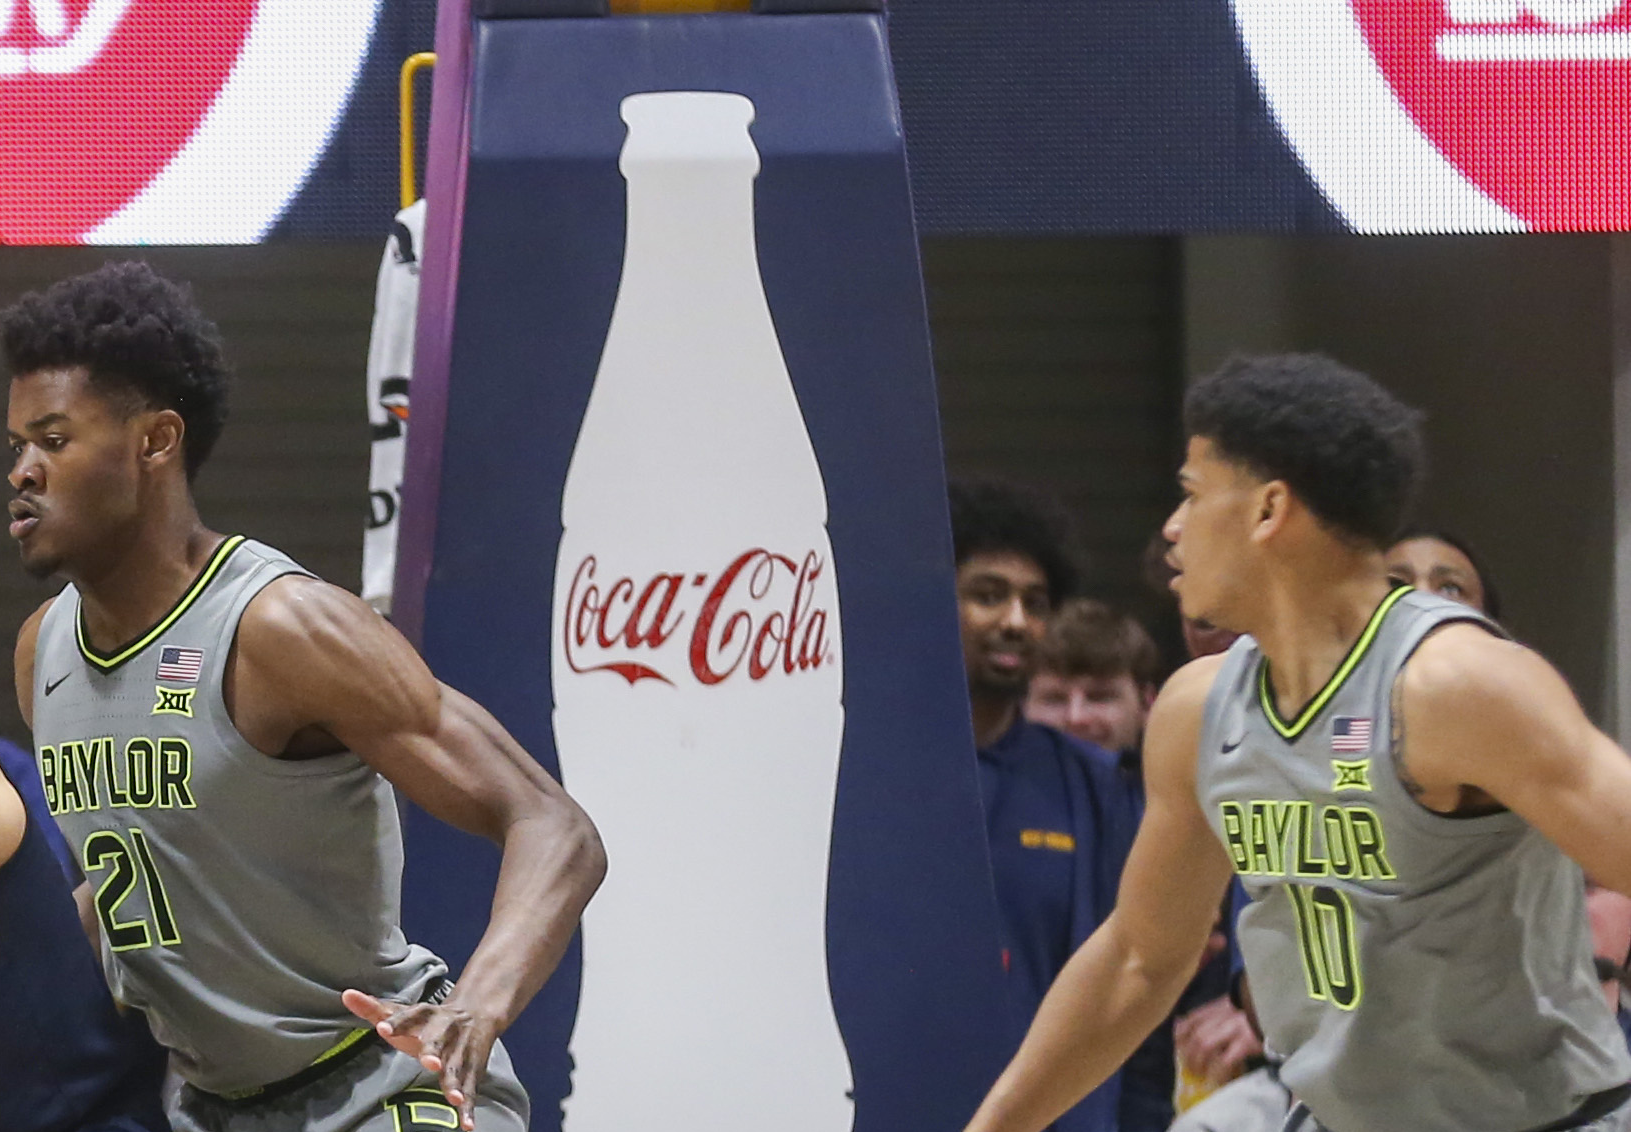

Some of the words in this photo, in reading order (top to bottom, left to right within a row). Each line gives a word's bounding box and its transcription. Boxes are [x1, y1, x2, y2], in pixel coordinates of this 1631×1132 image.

[565, 547, 830, 686] Coca-Cola
[154, 688, 192, 715] XII
[40, 737, 197, 816] BAYLOR
[1219, 801, 1397, 879] BAYLOR
[83, 830, 181, 952] 21
[1286, 883, 1362, 1011] 10
